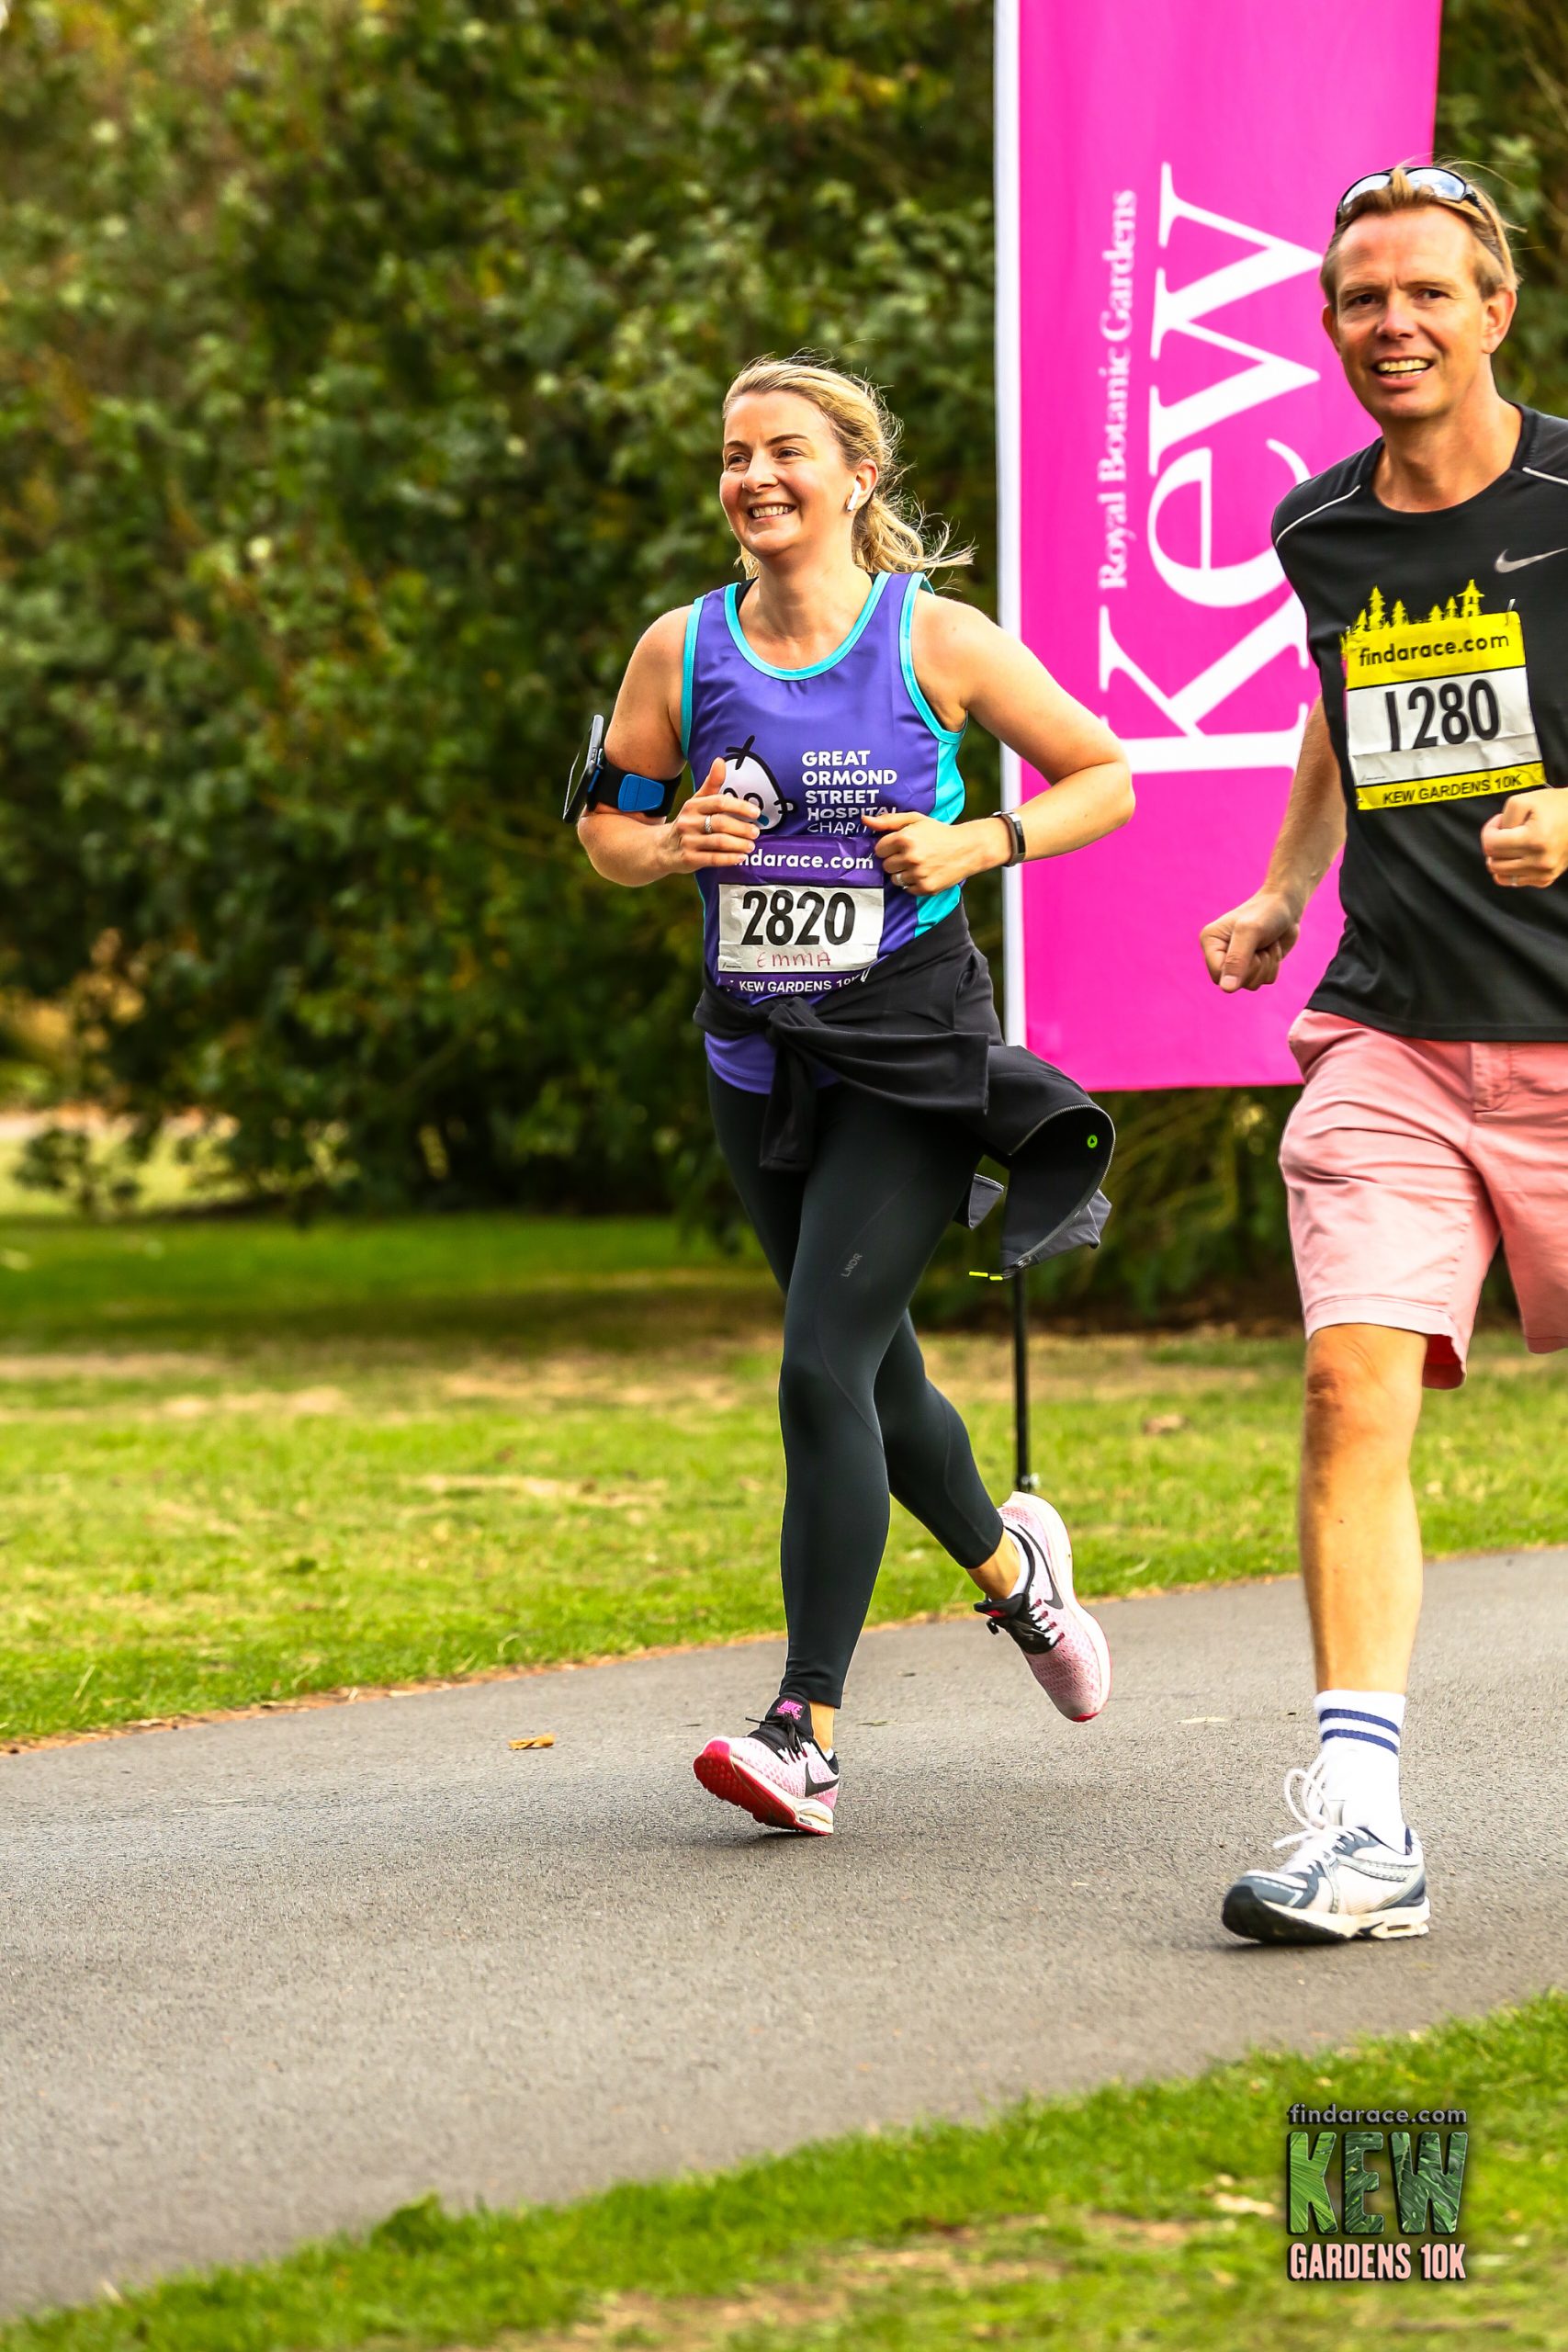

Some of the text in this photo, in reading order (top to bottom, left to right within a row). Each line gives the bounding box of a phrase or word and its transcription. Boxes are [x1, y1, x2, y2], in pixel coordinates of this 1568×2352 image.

[1097, 189, 1138, 590] Royal Botanic Gardens
[1100, 161, 1322, 775] Kew
[1359, 633, 1510, 667] findarace.com
[1384, 678, 1502, 752] 1280
[801, 749, 871, 767] GREAT
[801, 769, 897, 786] ORMOND
[1382, 773, 1523, 805] KEW GARDENS 10K
[805, 789, 880, 805] STREET
[807, 821, 875, 835] CHARI
[734, 848, 874, 870] ndarace.com
[740, 888, 856, 946] 2820
[739, 980, 767, 992] KEW
[767, 979, 832, 993] GARDENS
